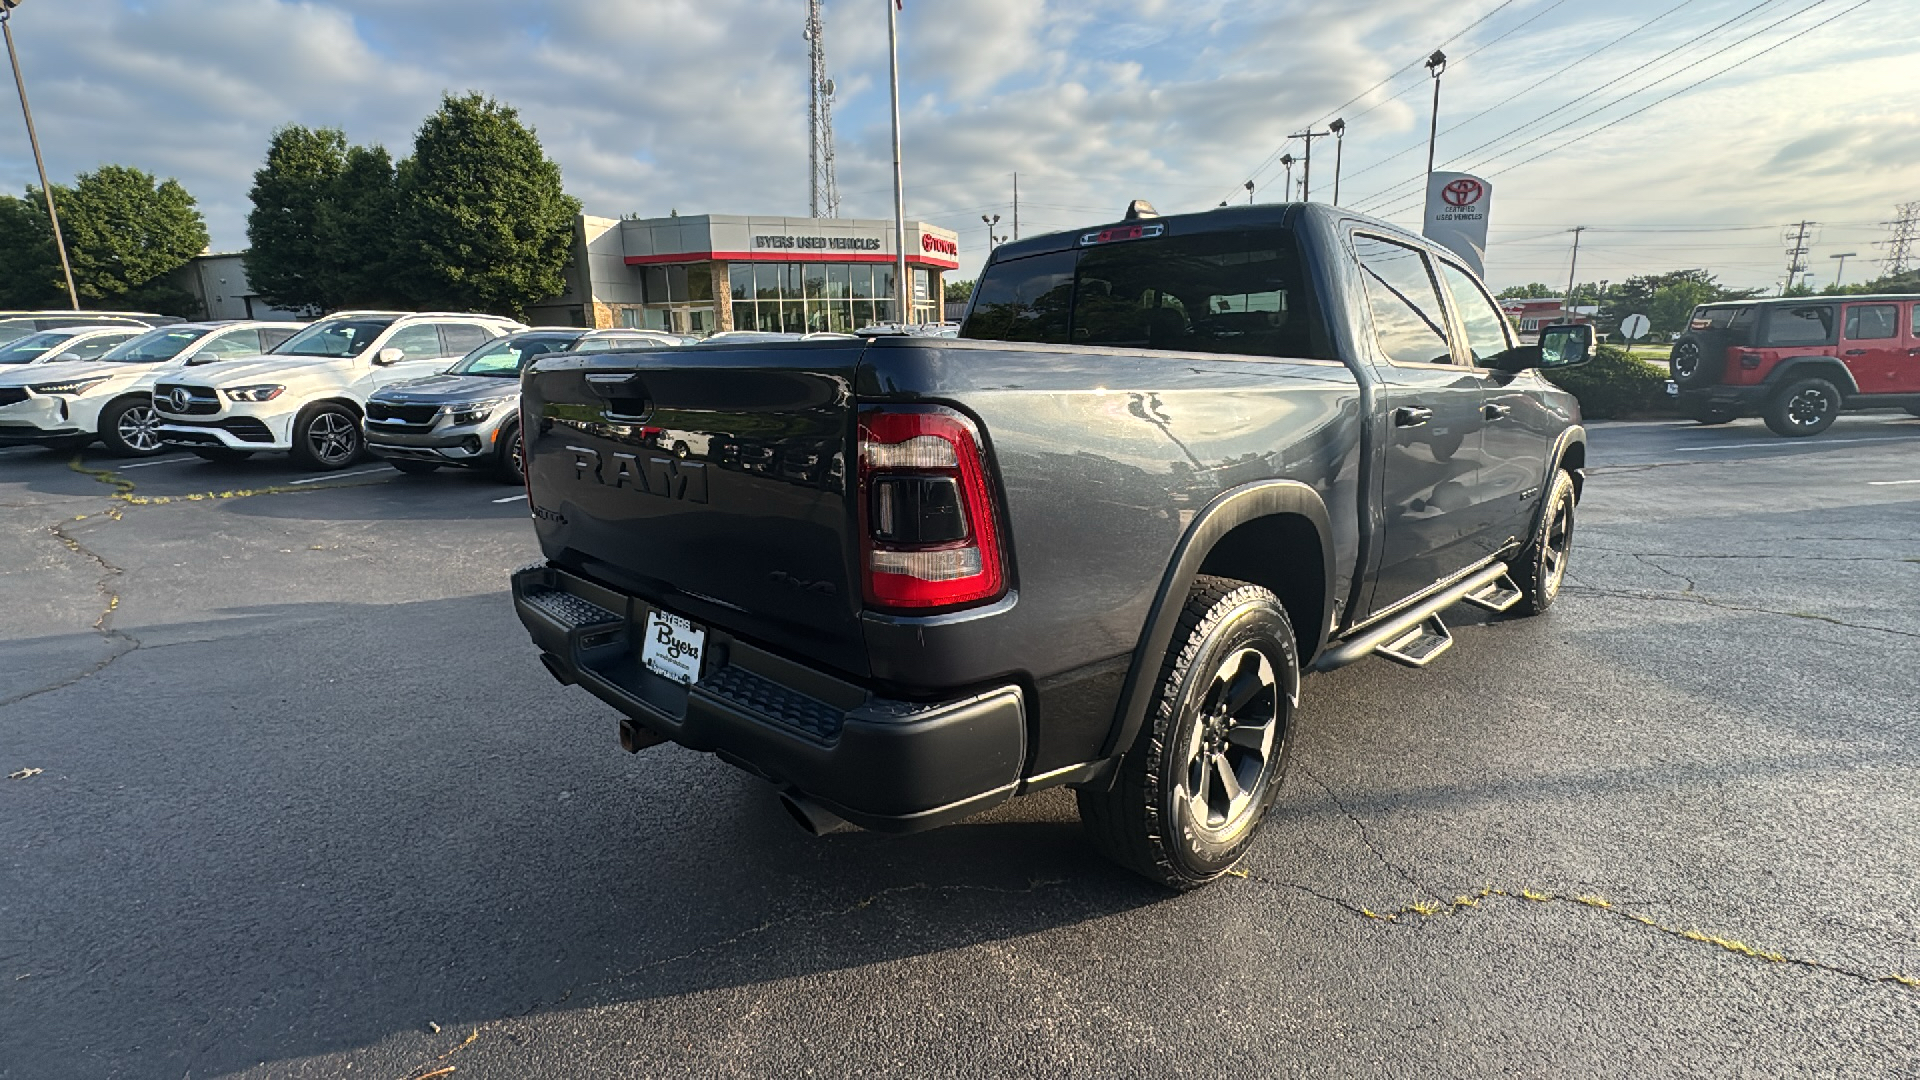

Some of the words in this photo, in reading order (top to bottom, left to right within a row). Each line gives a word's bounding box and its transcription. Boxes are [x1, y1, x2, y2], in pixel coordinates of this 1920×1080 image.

[756, 235, 795, 249] BYERS
[796, 236, 827, 249] USED
[828, 237, 881, 251] VEHICLES
[932, 237, 957, 257] TOYOTA
[566, 445, 709, 504] RAM
[660, 610, 691, 631] BYERS
[653, 621, 699, 660] Byers
